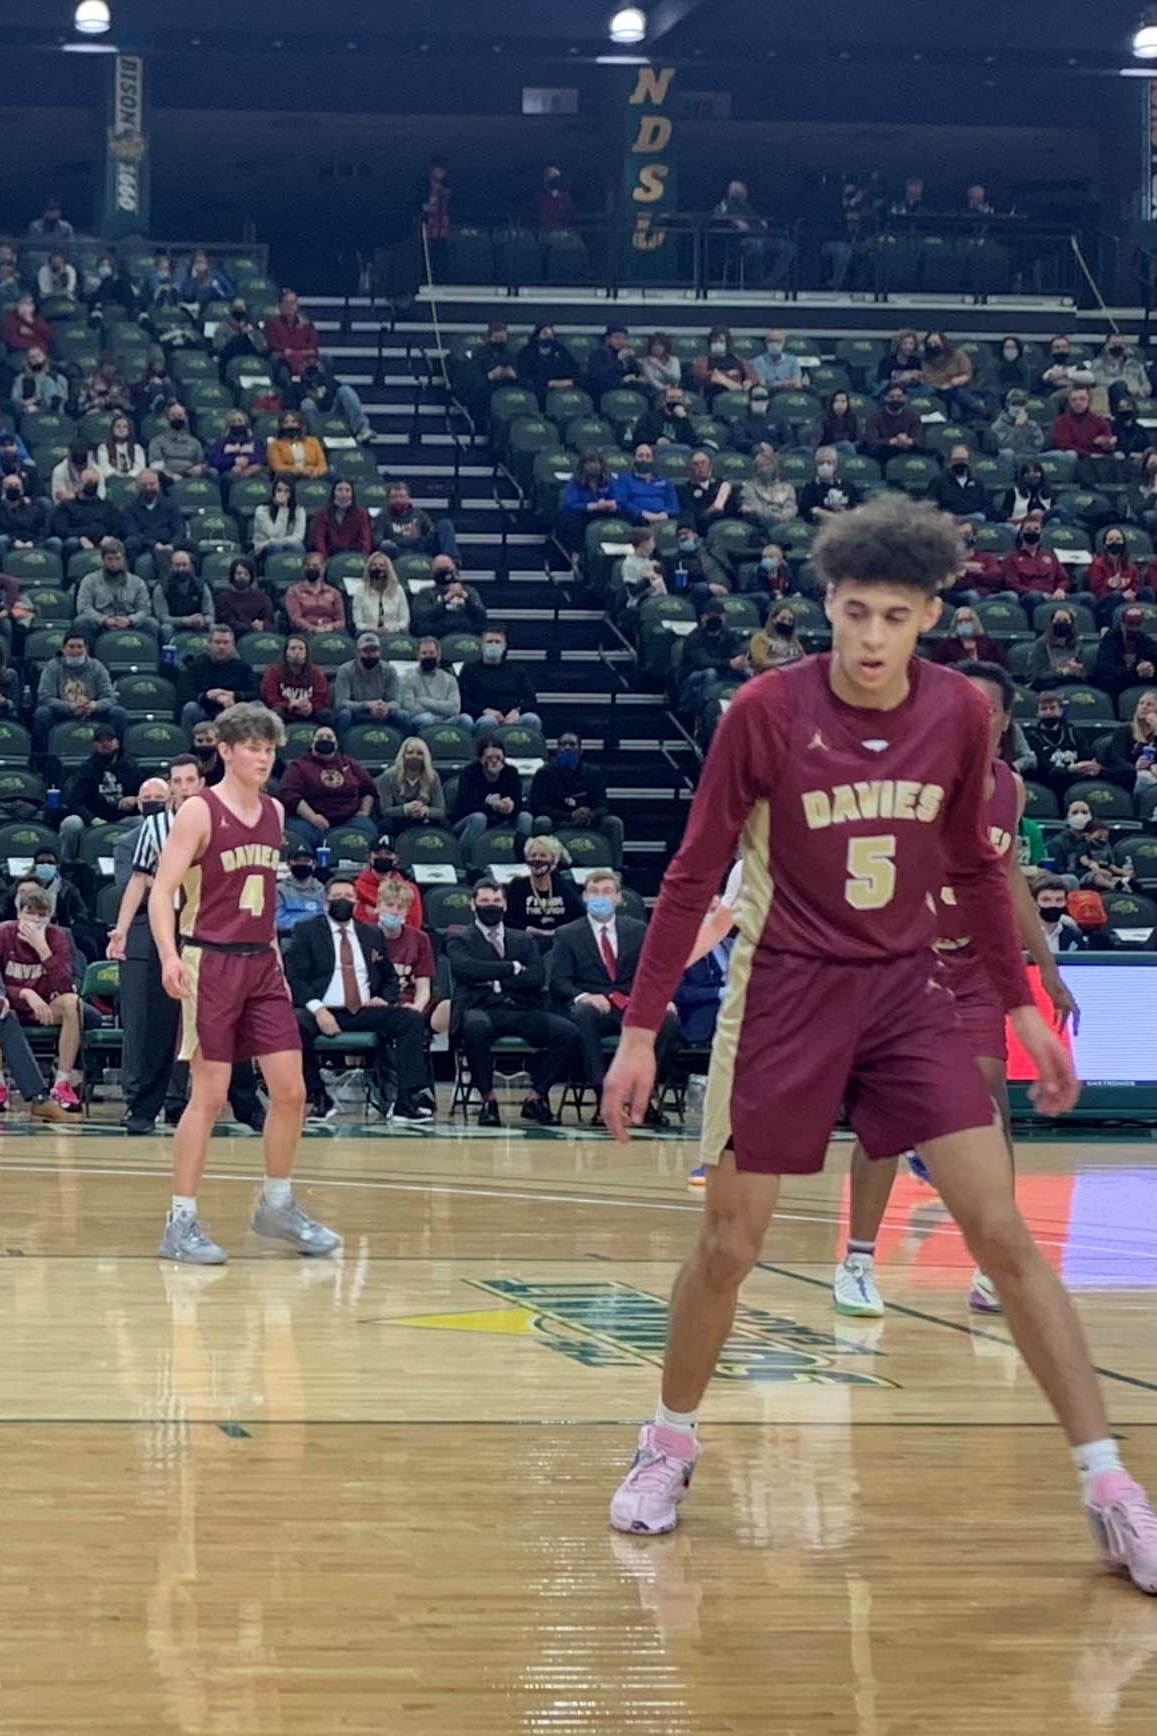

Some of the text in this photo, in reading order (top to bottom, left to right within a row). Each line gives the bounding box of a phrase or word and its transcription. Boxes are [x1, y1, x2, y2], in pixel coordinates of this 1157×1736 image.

[120, 58, 138, 131] BISON
[802, 780, 944, 829] DAVIES
[239, 874, 264, 917] 4
[844, 835, 896, 910] 5
